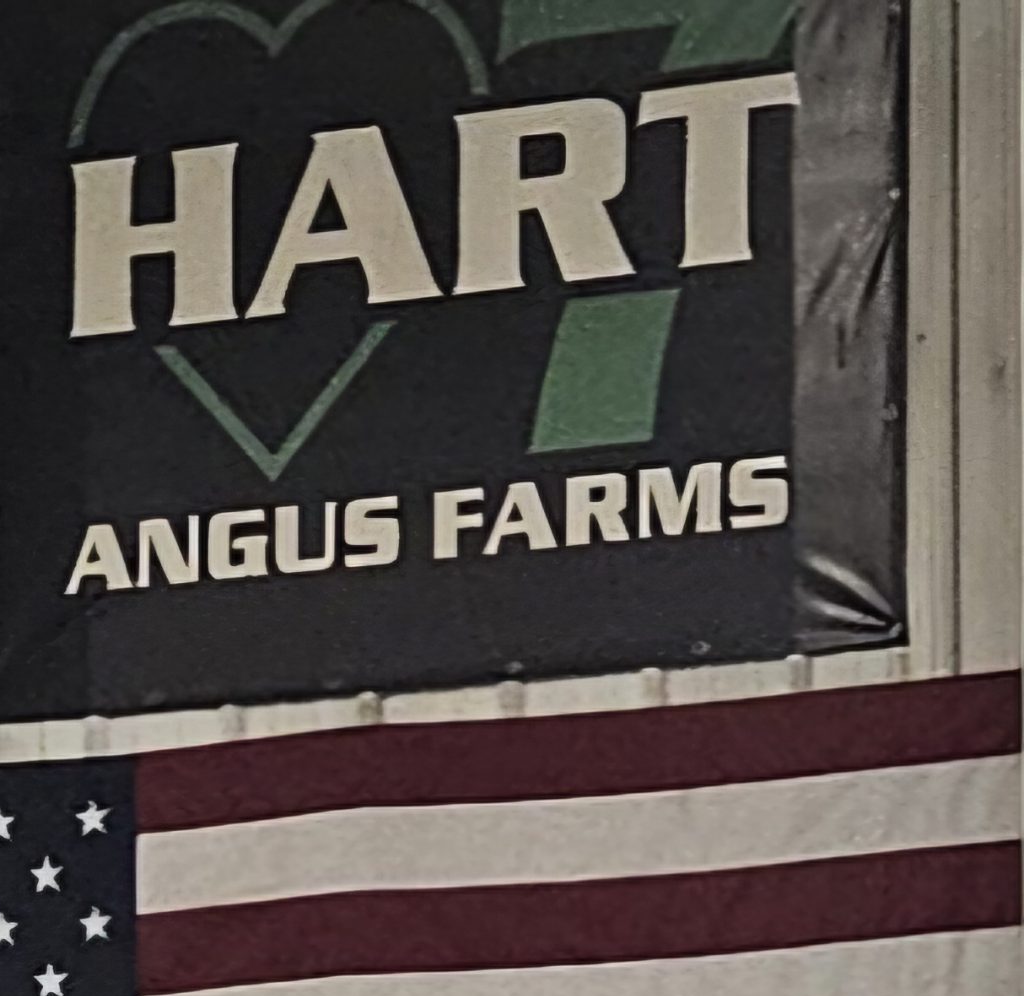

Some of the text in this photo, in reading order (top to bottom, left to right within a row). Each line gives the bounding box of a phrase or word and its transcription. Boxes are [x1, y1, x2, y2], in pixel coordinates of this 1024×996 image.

[70, 71, 802, 338] HART
[63, 455, 789, 595] ANGUS FARMS
